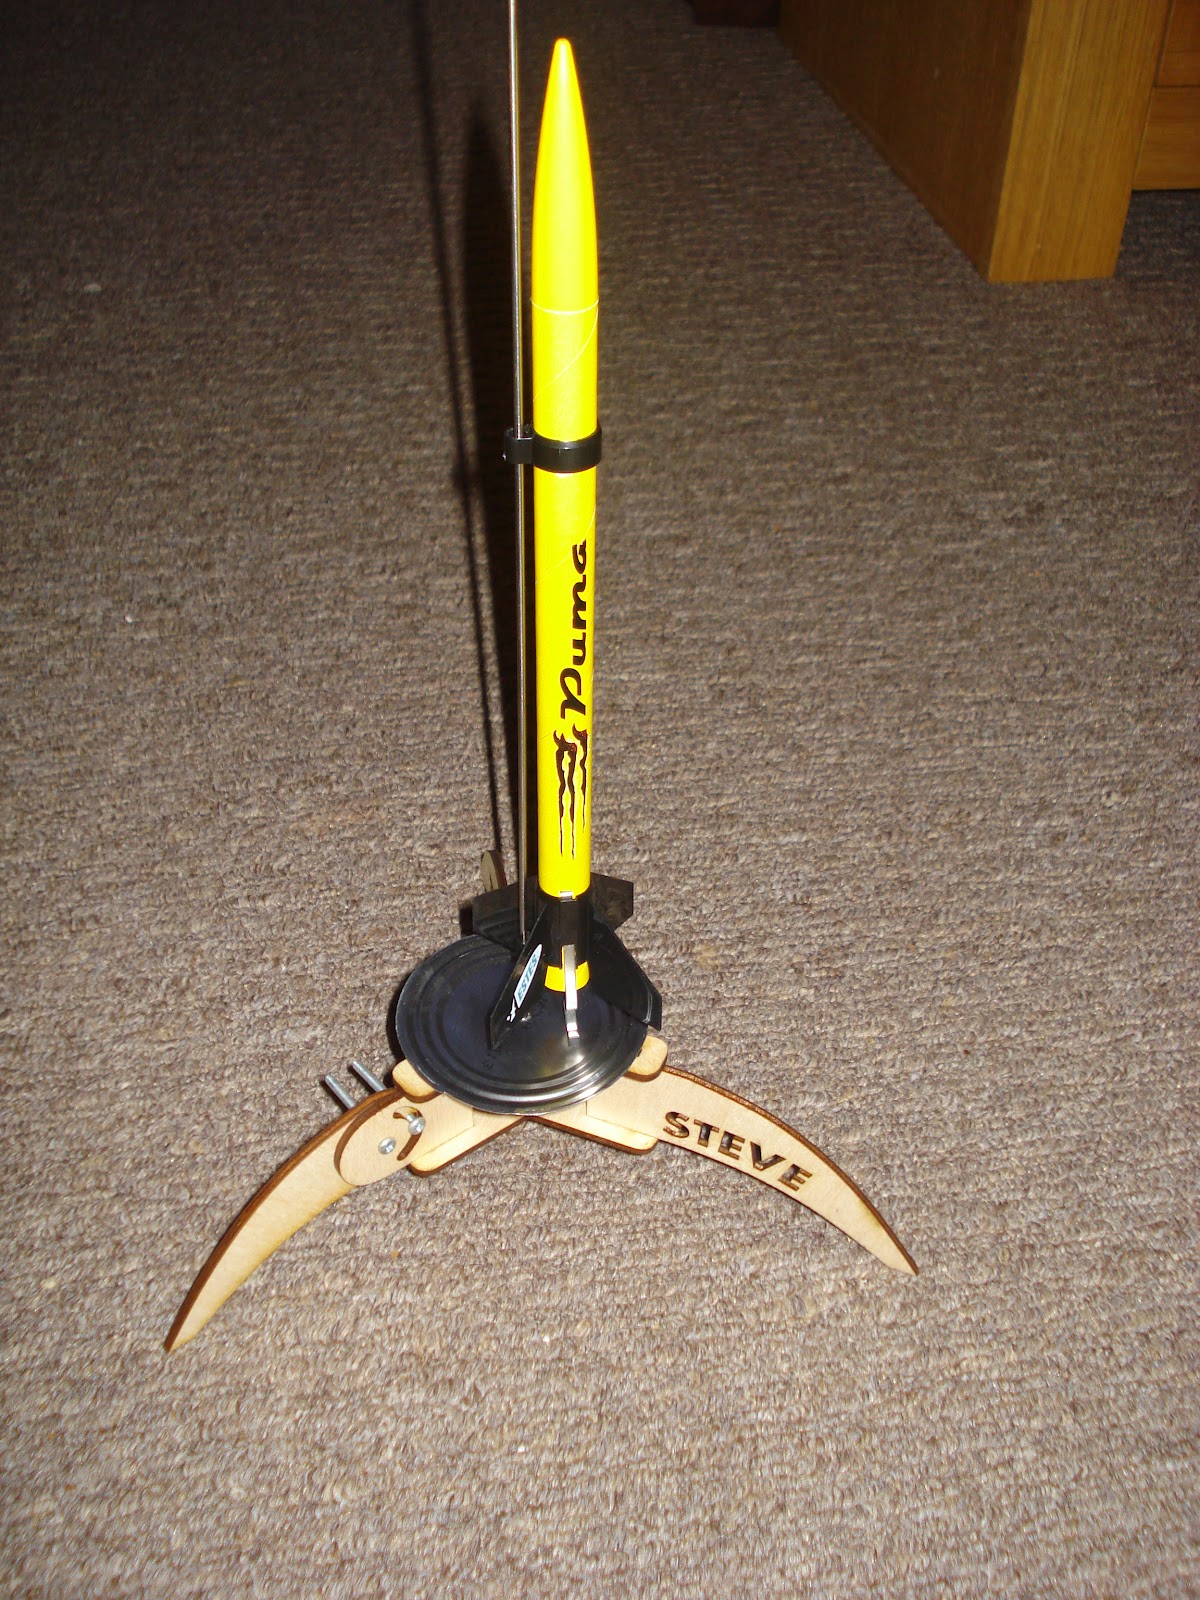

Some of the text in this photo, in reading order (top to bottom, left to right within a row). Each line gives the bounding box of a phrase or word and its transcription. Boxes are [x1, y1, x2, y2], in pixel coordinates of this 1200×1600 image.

[560, 539, 587, 719] Puma
[517, 953, 539, 1002] ESTES
[663, 1111, 812, 1191] STEVE
